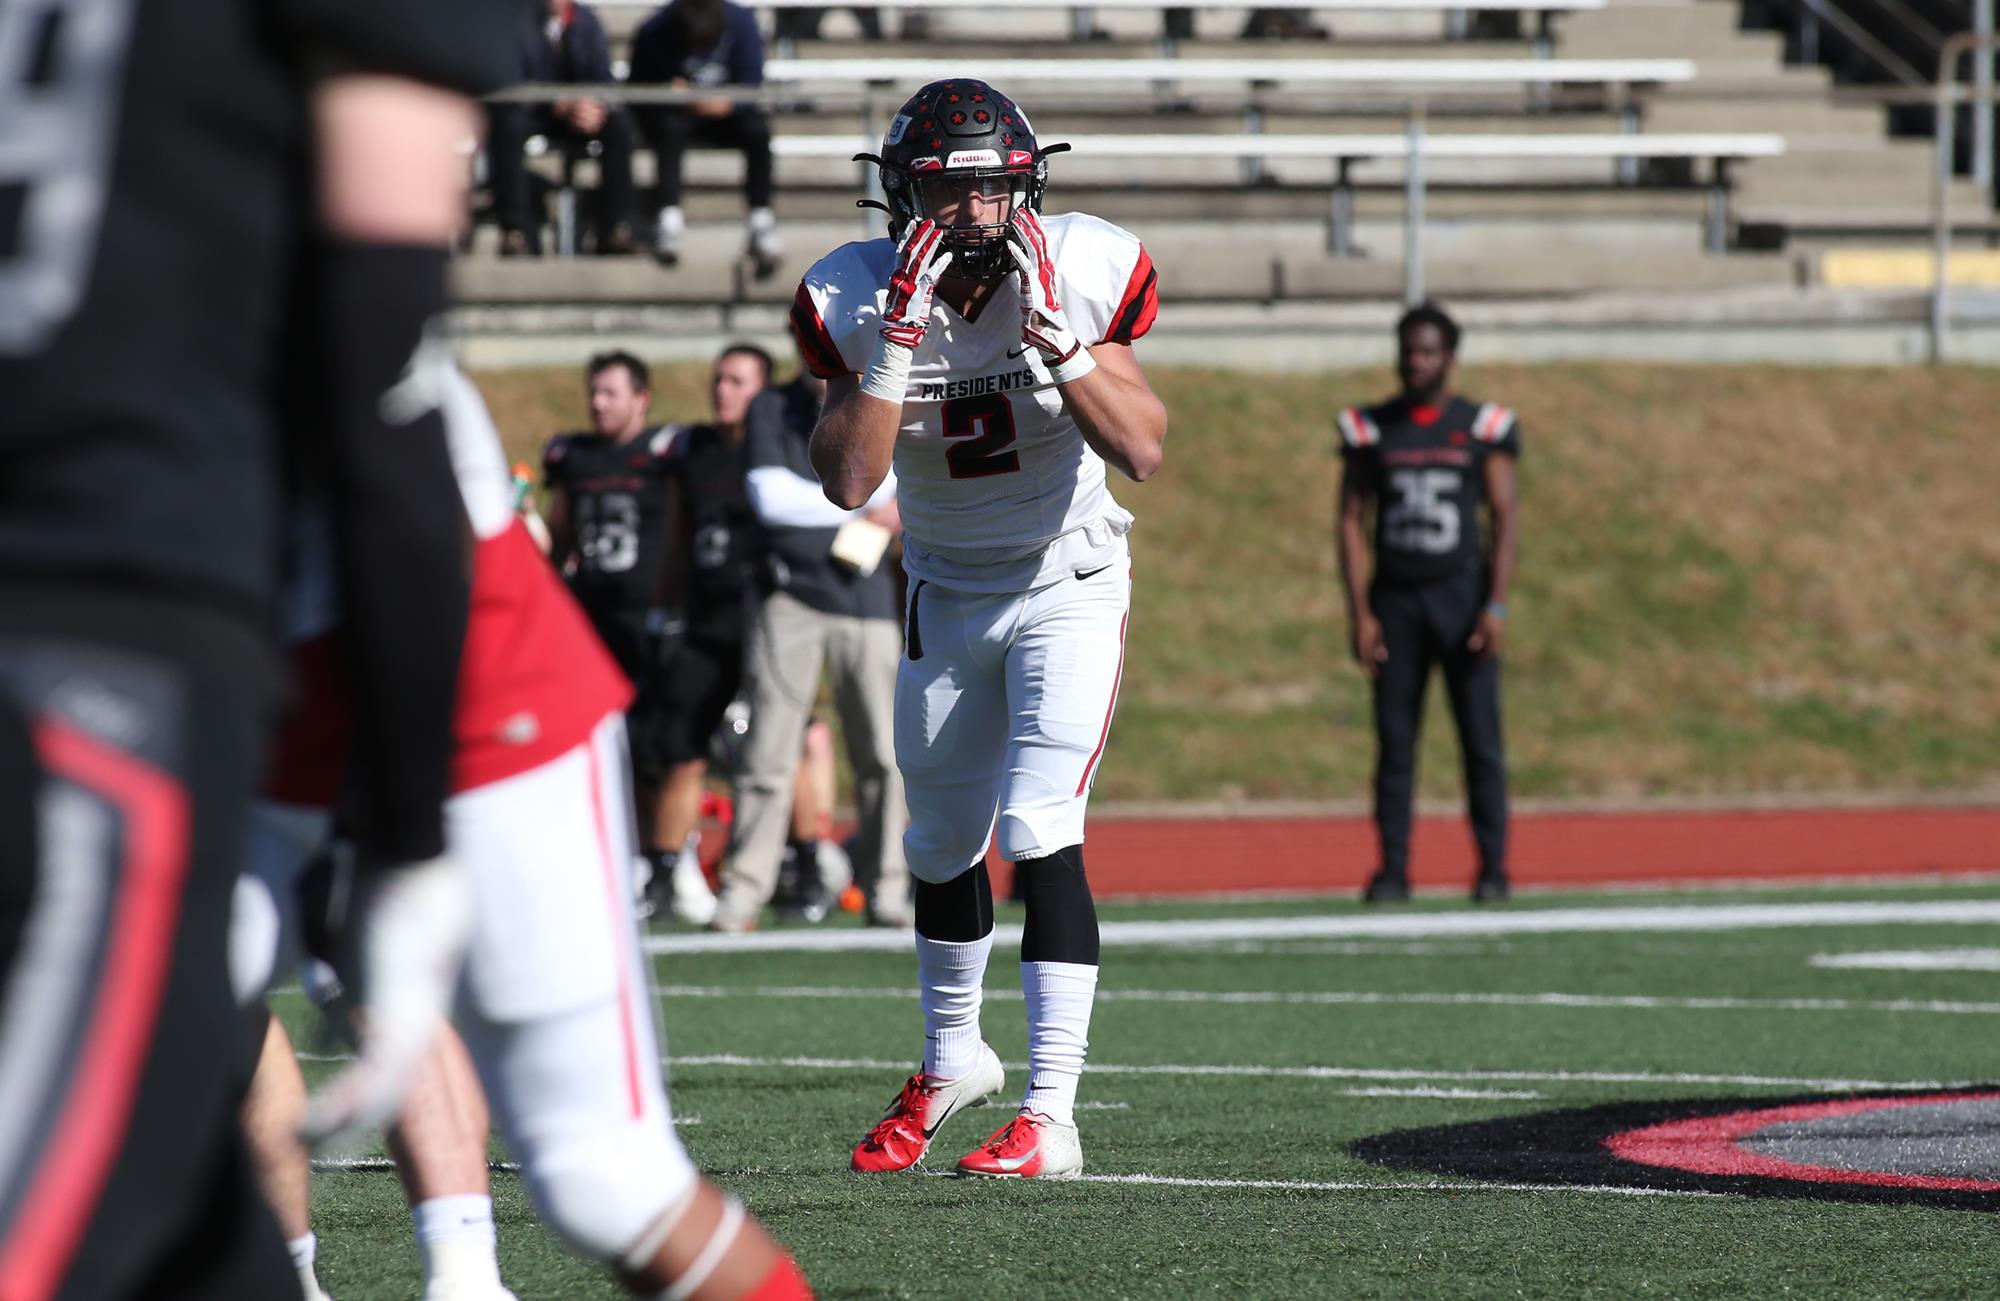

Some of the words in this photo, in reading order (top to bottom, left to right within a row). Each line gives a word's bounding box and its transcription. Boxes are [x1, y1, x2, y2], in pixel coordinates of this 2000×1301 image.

[921, 369, 1034, 400] PRESIDENTS
[941, 391, 1021, 480] 2
[1385, 468, 1463, 553] 25
